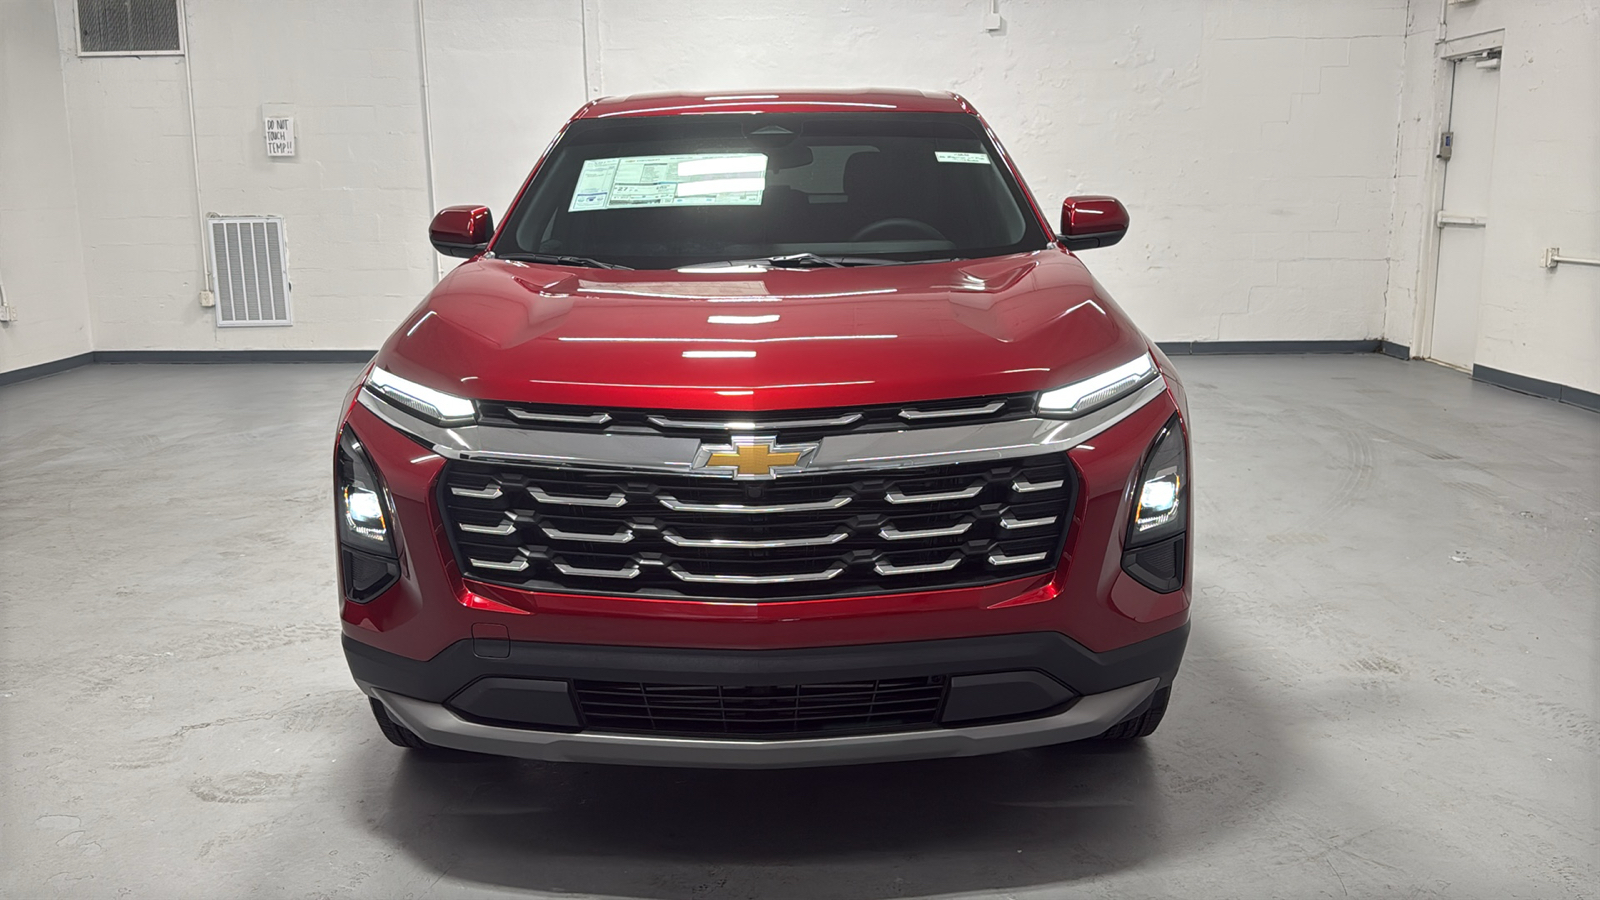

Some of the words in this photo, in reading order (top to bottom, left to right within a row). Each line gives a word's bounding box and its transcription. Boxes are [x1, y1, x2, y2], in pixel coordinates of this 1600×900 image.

[267, 119, 275, 130] DO
[276, 119, 289, 130] NOT
[267, 131, 286, 141] TOUCH
